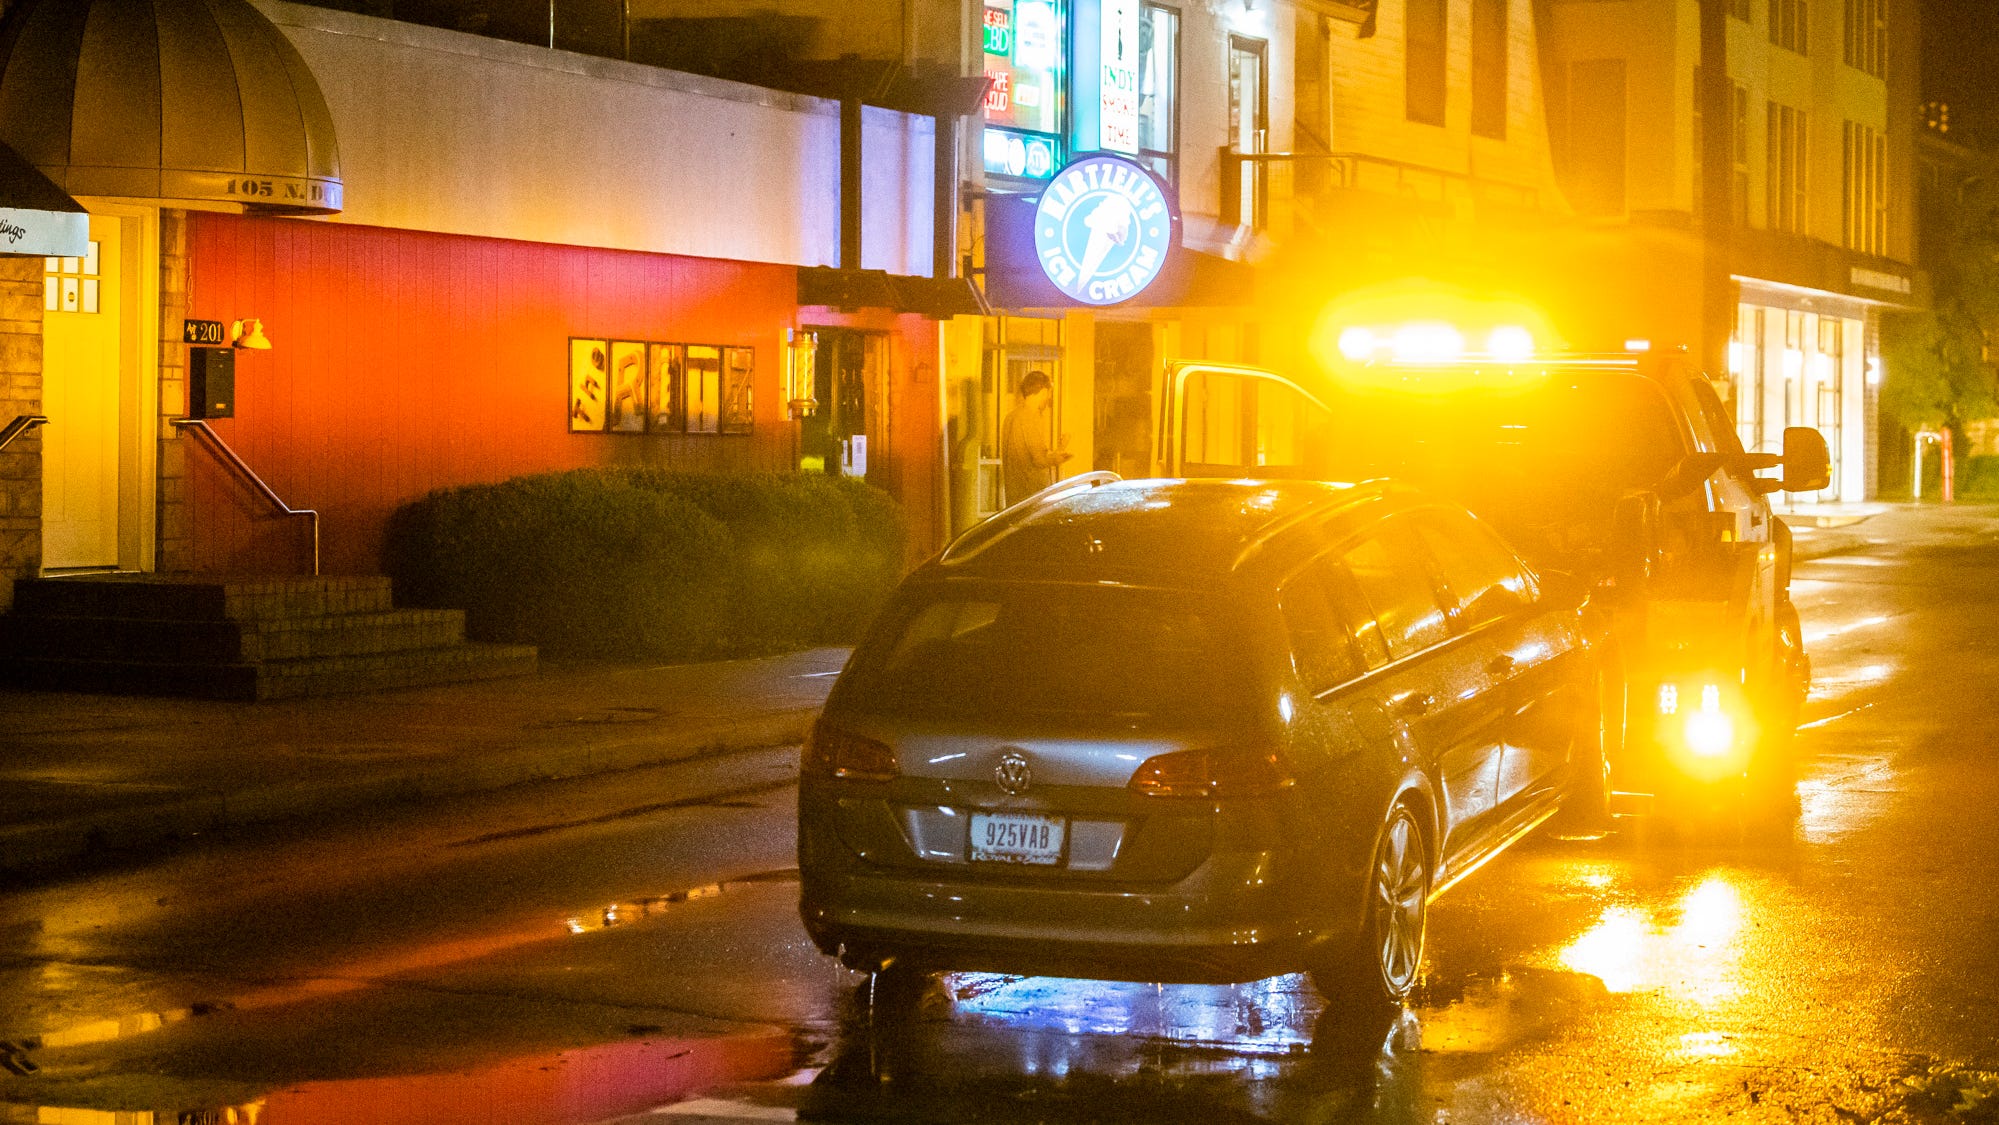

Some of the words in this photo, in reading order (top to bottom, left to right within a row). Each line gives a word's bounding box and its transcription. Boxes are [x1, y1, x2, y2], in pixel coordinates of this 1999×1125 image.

[984, 24, 1009, 52] CBD
[1104, 65, 1135, 92] INDY
[1107, 124, 1131, 145] TIME
[226, 179, 273, 197] 105
[284, 183, 305, 200] N.
[1041, 163, 1163, 222] HARTZELL'S
[1043, 246, 1077, 287] ICE
[1088, 245, 1159, 300] CREAM
[199, 322, 221, 341] 201
[986, 822, 1050, 849] 925VAB
